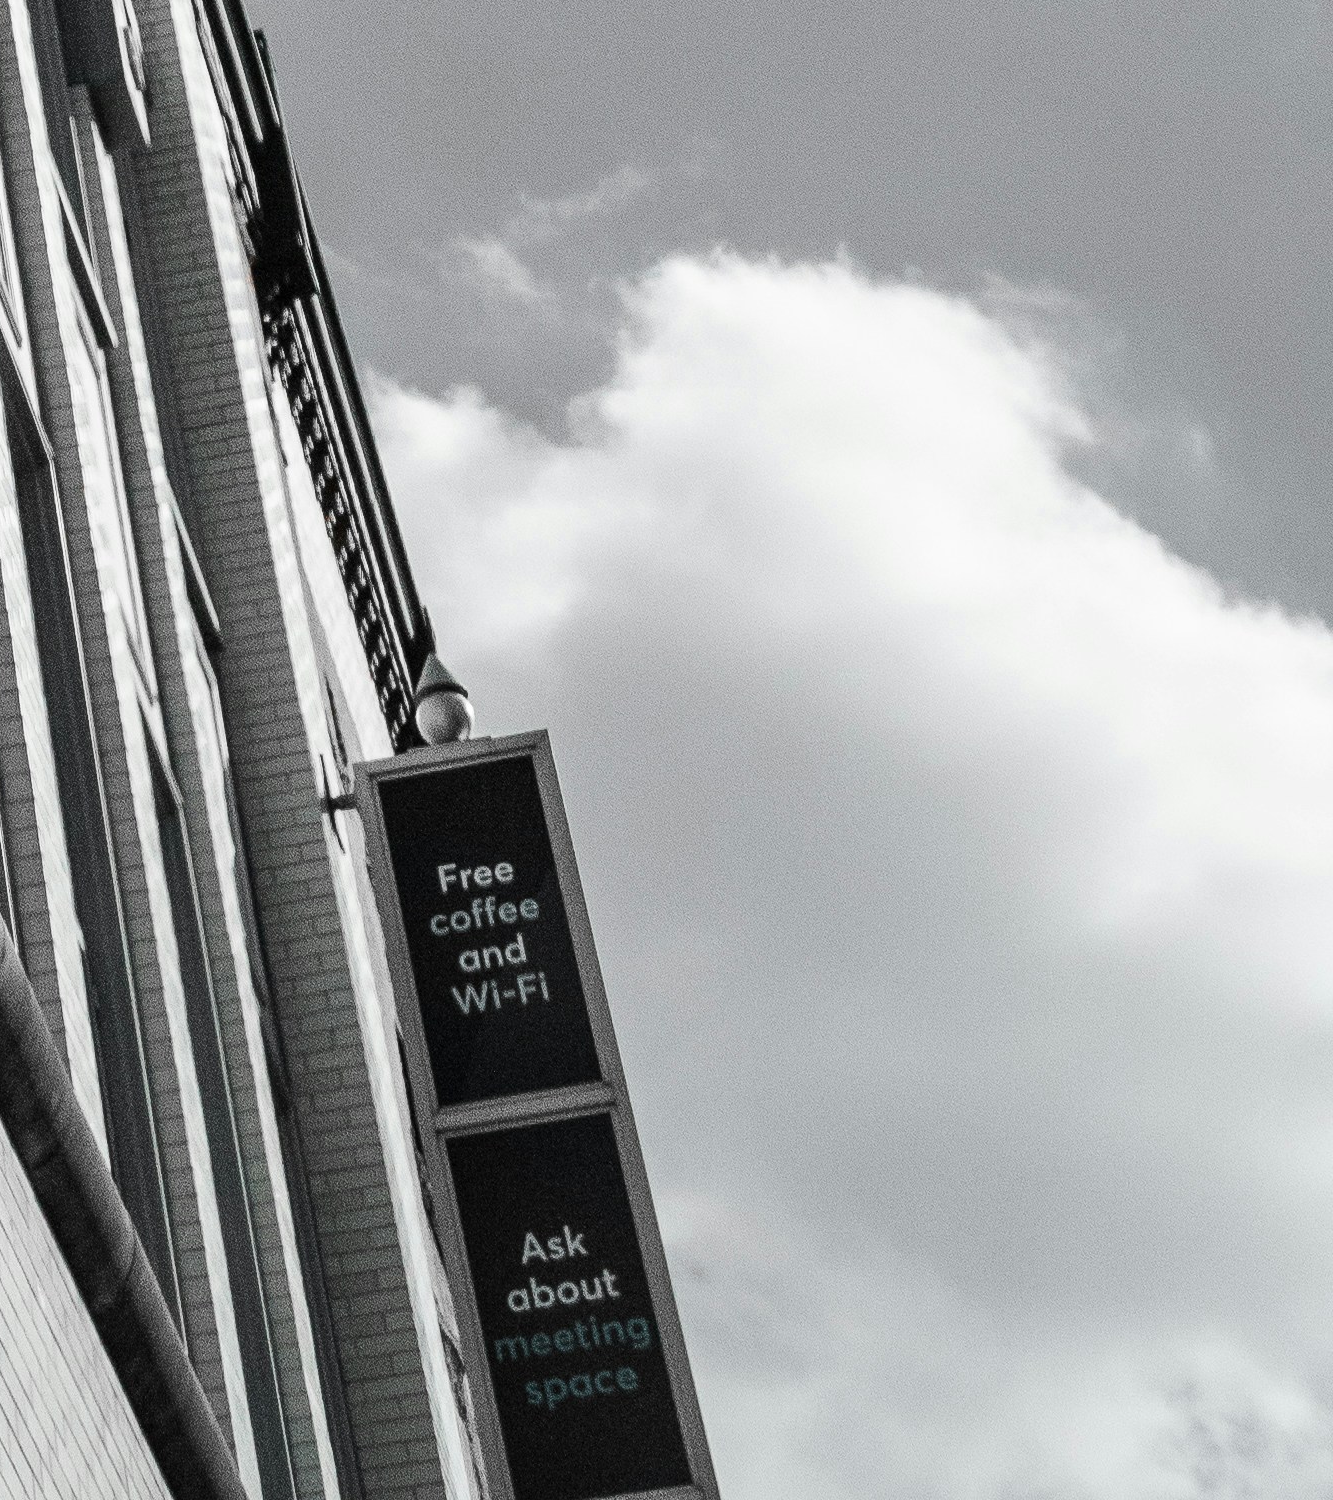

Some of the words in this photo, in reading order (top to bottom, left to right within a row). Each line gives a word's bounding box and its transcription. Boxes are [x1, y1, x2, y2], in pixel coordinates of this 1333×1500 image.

[436, 860, 515, 893] Free
[429, 895, 540, 938] coffee
[458, 935, 529, 974] and
[451, 971, 550, 1017] Wi-Fi
[521, 1226, 587, 1264] Ask
[506, 1268, 620, 1313] about
[493, 1312, 652, 1364] meeting
[525, 1364, 640, 1412] space
